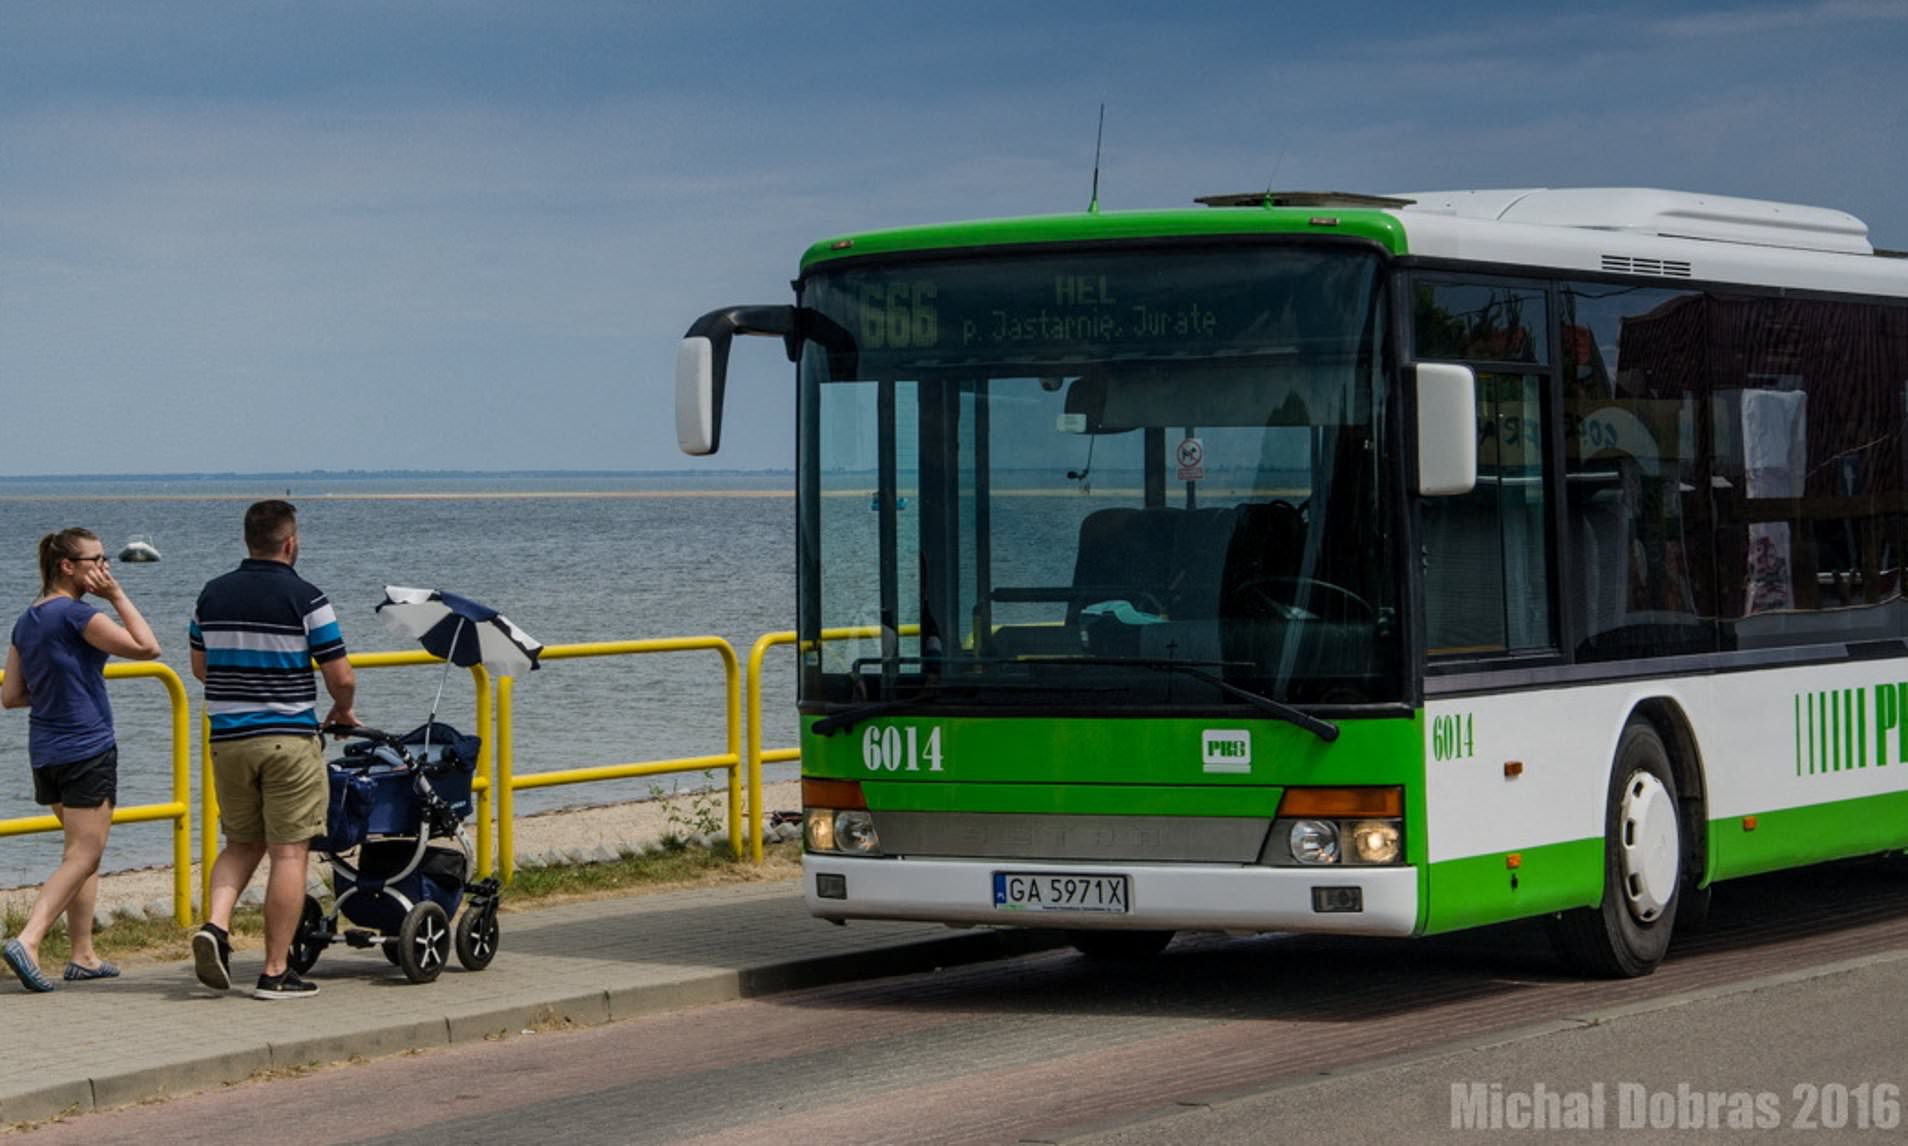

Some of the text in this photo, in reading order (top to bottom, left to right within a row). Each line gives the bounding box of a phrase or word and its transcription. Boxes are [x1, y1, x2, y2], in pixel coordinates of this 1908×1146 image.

[1056, 274, 1117, 305] HEL
[859, 280, 939, 349] 666
[963, 318, 984, 346] p.
[862, 725, 945, 772] 6014
[1432, 711, 1475, 762] 6014
[1009, 877, 1122, 904] GA 5971X
